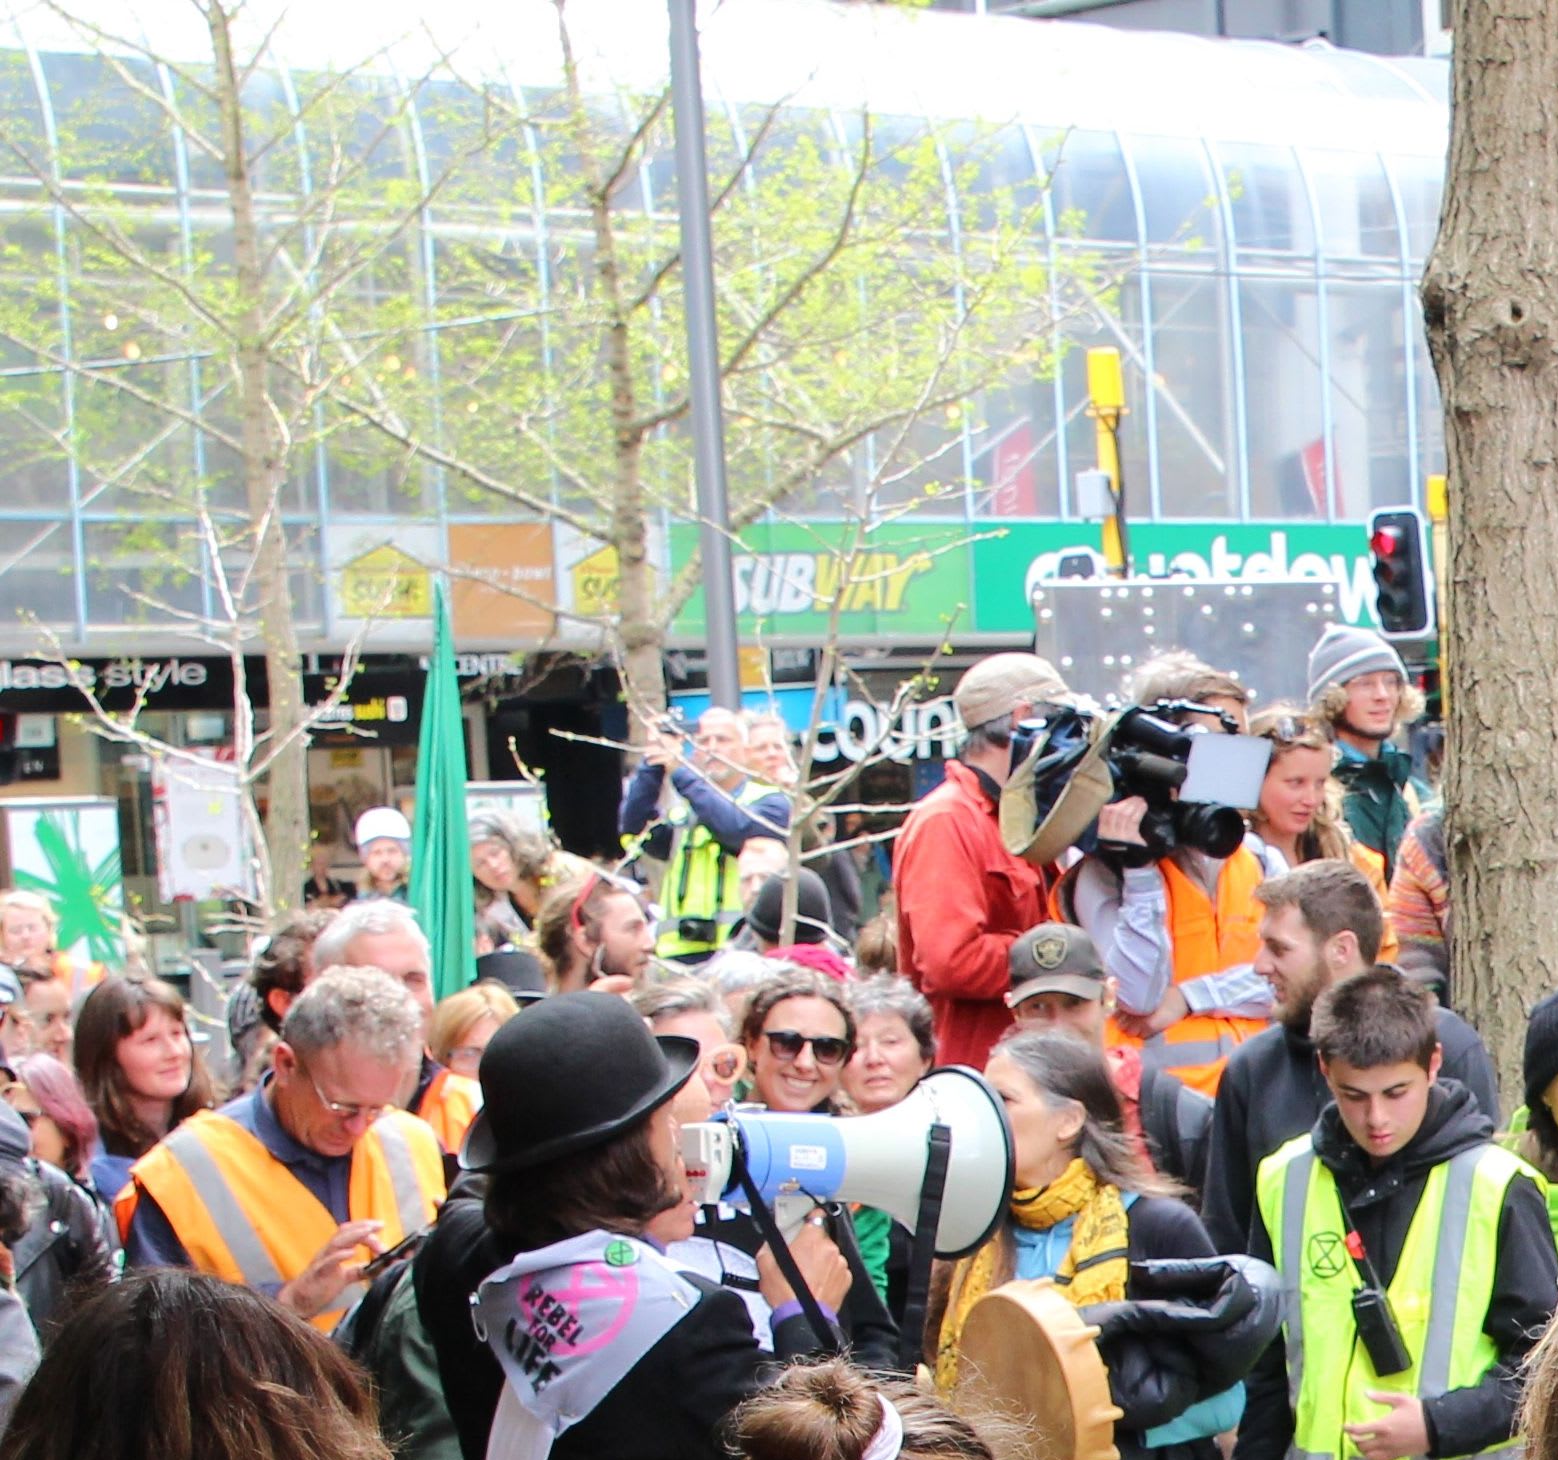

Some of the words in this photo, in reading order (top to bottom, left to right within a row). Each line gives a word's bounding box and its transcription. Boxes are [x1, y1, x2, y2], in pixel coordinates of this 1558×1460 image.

[733, 552, 932, 614] SUBWAY
[0, 660, 97, 689] lass
[104, 658, 207, 692] style
[522, 1284, 583, 1347] REBEL
[505, 1317, 562, 1396] LIFE
